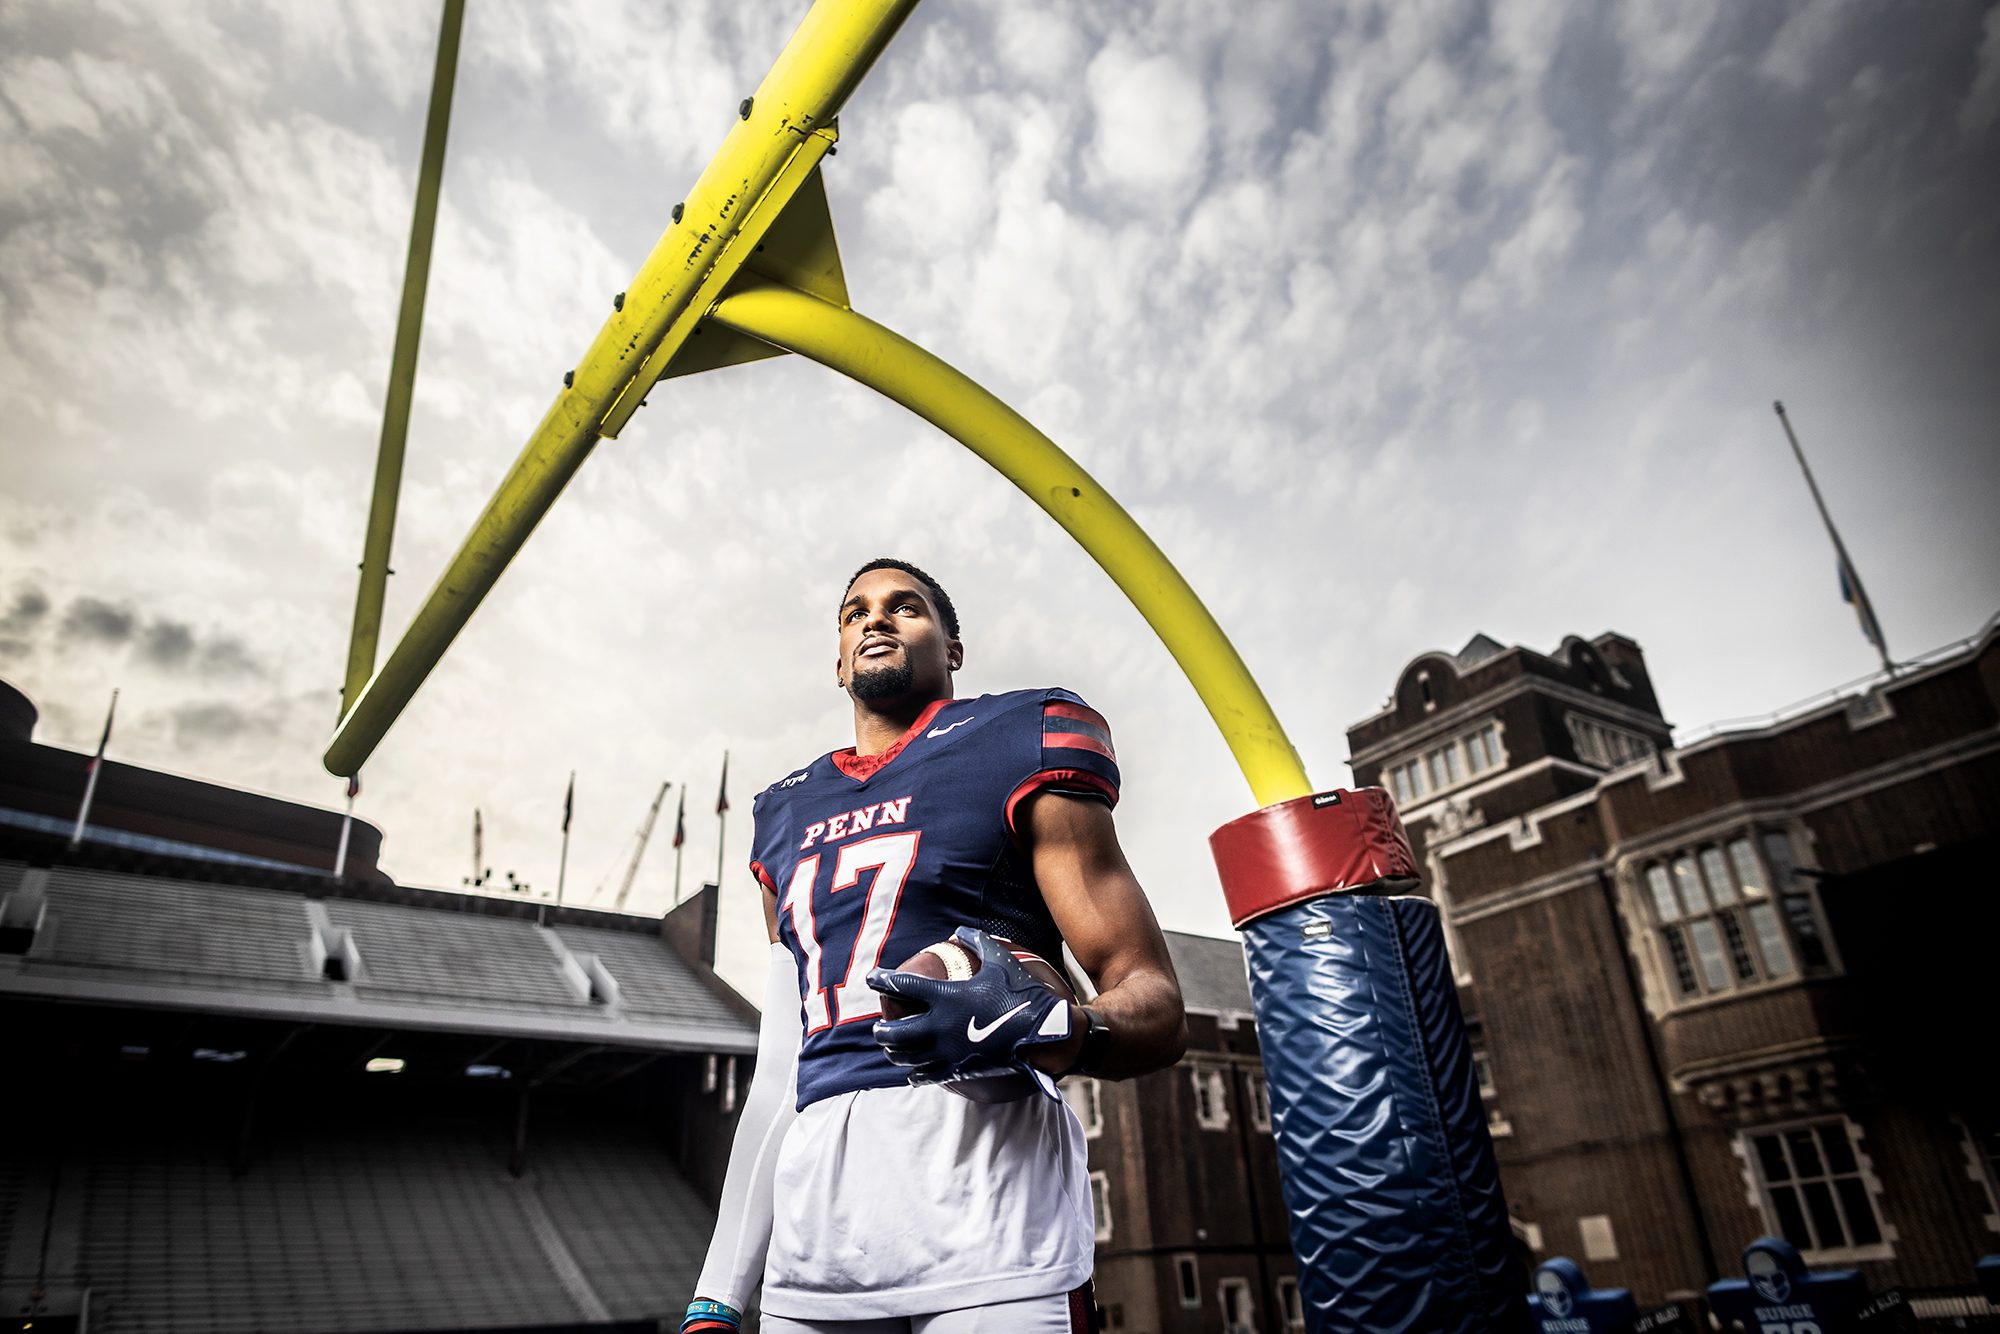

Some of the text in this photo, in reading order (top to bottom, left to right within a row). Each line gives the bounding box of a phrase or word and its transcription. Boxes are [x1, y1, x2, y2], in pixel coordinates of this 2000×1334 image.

[800, 796, 913, 851] PENN
[783, 830, 922, 1037] 17
[1754, 1303, 1816, 1322] SURGE
